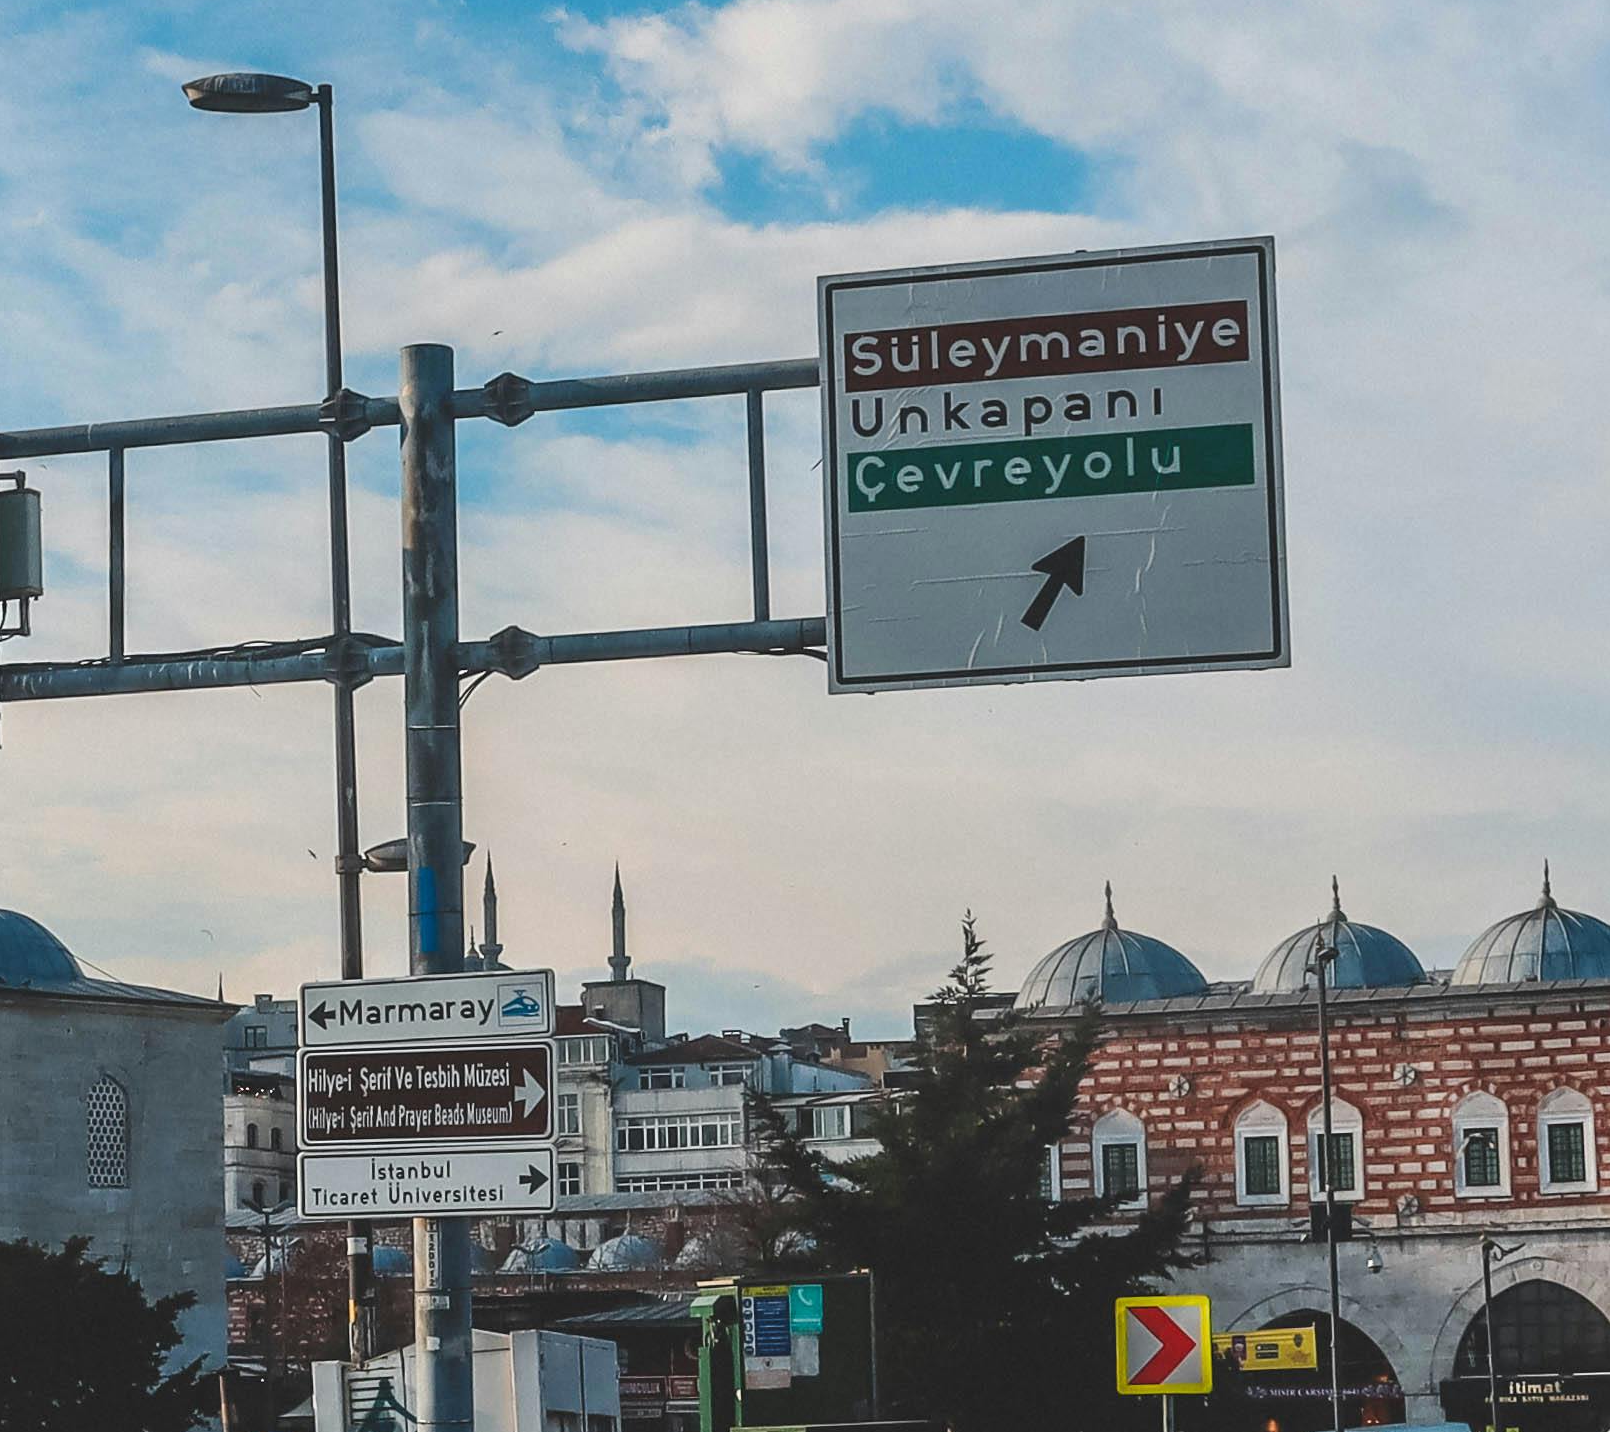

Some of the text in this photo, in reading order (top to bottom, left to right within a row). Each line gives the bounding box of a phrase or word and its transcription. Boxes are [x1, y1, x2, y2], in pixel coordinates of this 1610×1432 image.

[851, 314, 1241, 377] Süleymaniye
[851, 387, 1163, 438] Unkapanı
[855, 437, 1180, 504] Çevreyolu
[339, 998, 494, 1026] Marmaray
[308, 1062, 510, 1098] Hilye-i Şerif Ve Tesbih Müzesi
[308, 1102, 512, 1135] (Hilye-i Şerif And Prayer Beads Museum)
[371, 1158, 451, 1181] İstanbul
[312, 1182, 503, 1206] Ticaret Üniversitesi
